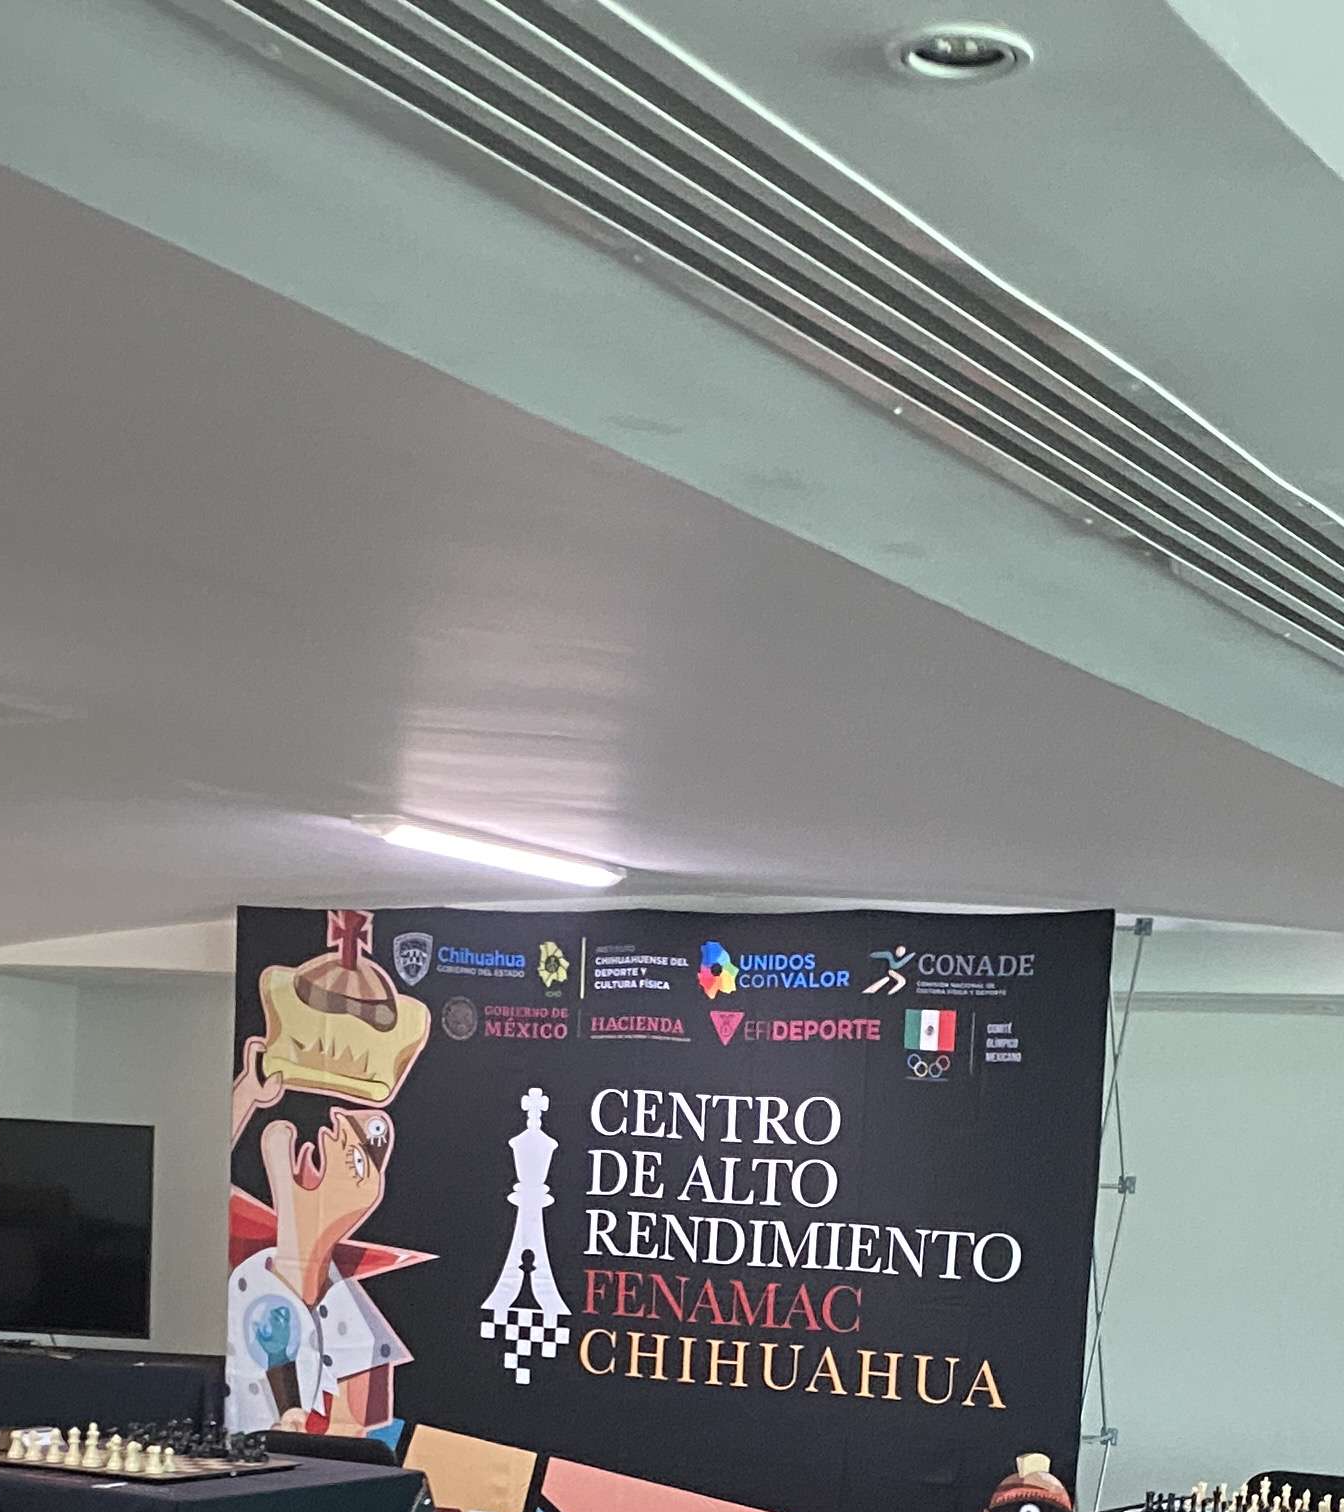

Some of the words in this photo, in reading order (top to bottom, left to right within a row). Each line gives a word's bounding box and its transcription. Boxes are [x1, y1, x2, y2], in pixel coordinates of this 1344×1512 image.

[438, 947, 525, 968] Chihuahua
[595, 956, 669, 966] CHIHUAHUENSE
[670, 958, 689, 967] DEL
[739, 954, 816, 971] UNIDOS
[918, 953, 1035, 977] CONADE
[494, 968, 525, 978] ESTADO
[594, 967, 638, 978] DEPORTE
[640, 967, 647, 977] Y
[739, 971, 850, 989] conVALOR
[594, 979, 638, 990] CULTURA
[484, 1005, 549, 1018] GOBIERNO
[551, 1007, 569, 1019] DE
[484, 1018, 568, 1040] MÉXICO
[591, 1015, 684, 1034] HACIENDA
[744, 1019, 881, 1041] EFIDEPORTE
[590, 1087, 842, 1146] CENTRO
[586, 1149, 664, 1199] DE
[677, 1155, 838, 1208] ALTO
[583, 1208, 1022, 1283] RENDIMIENTO
[582, 1268, 863, 1334] FENAMAC
[578, 1327, 1007, 1410] CHIHUAHUA
